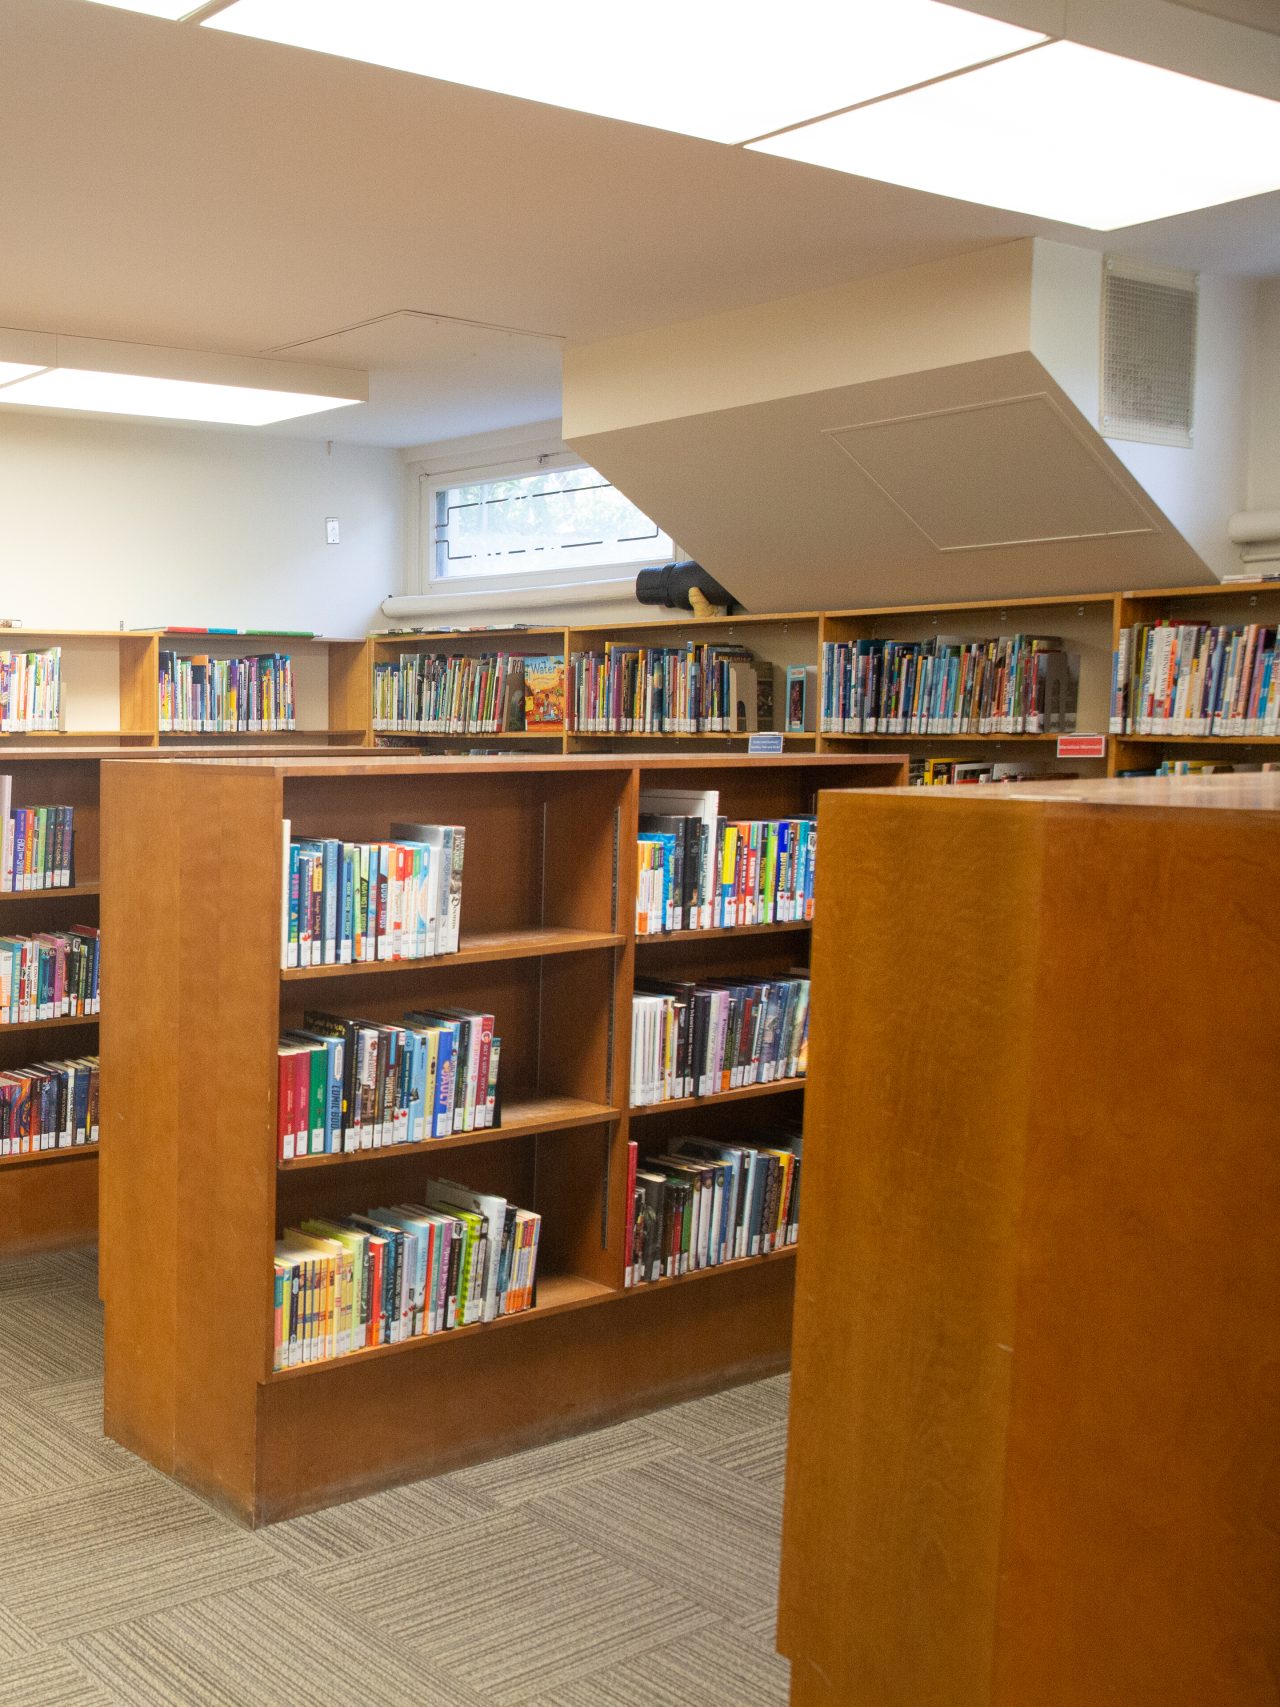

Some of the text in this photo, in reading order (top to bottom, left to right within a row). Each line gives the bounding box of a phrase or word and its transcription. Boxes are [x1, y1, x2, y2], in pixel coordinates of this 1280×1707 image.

[530, 663, 556, 674] Water
[778, 852, 788, 891] NOTORIOUS
[482, 1044, 490, 1056] GET
[330, 1085, 341, 1109] COMIC
[385, 1076, 395, 1107] INVISIBLE
